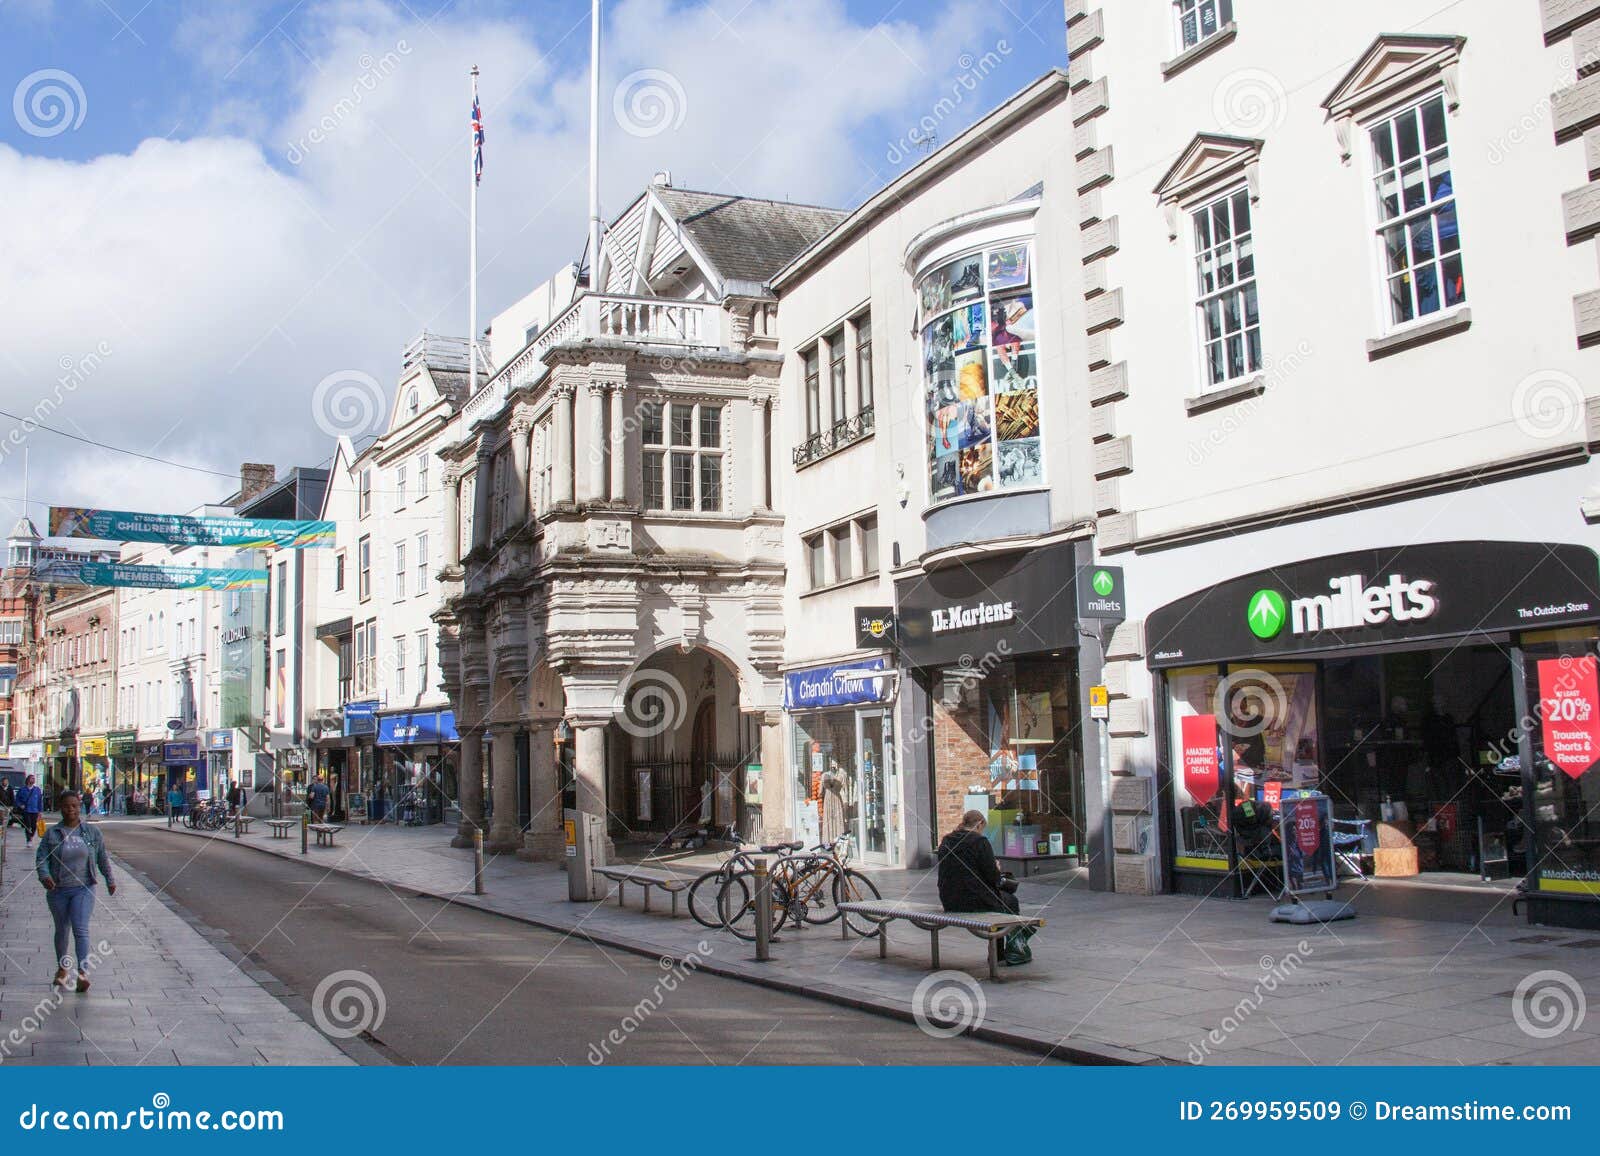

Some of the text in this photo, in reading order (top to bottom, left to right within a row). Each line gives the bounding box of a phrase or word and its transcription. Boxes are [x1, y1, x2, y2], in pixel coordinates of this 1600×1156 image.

[117, 521, 180, 534] CHILDRENS
[181, 526, 211, 536] SOFT
[211, 526, 240, 537] PLAY
[241, 528, 271, 538] AREA
[113, 571, 196, 584] MEMBERSHIPS
[1088, 599, 1121, 611] millets
[1291, 574, 1436, 634] millets
[1518, 603, 1589, 618] The Outdoor Store
[799, 676, 833, 699] Chandni
[1548, 698, 1591, 721] 20% off
[1185, 747, 1214, 756] AMAZING
[1553, 741, 1591, 752] Shorts &
[1186, 757, 1214, 765] CAMPING
[1556, 753, 1590, 763] Fleeces
[1191, 766, 1210, 774] DEALS
